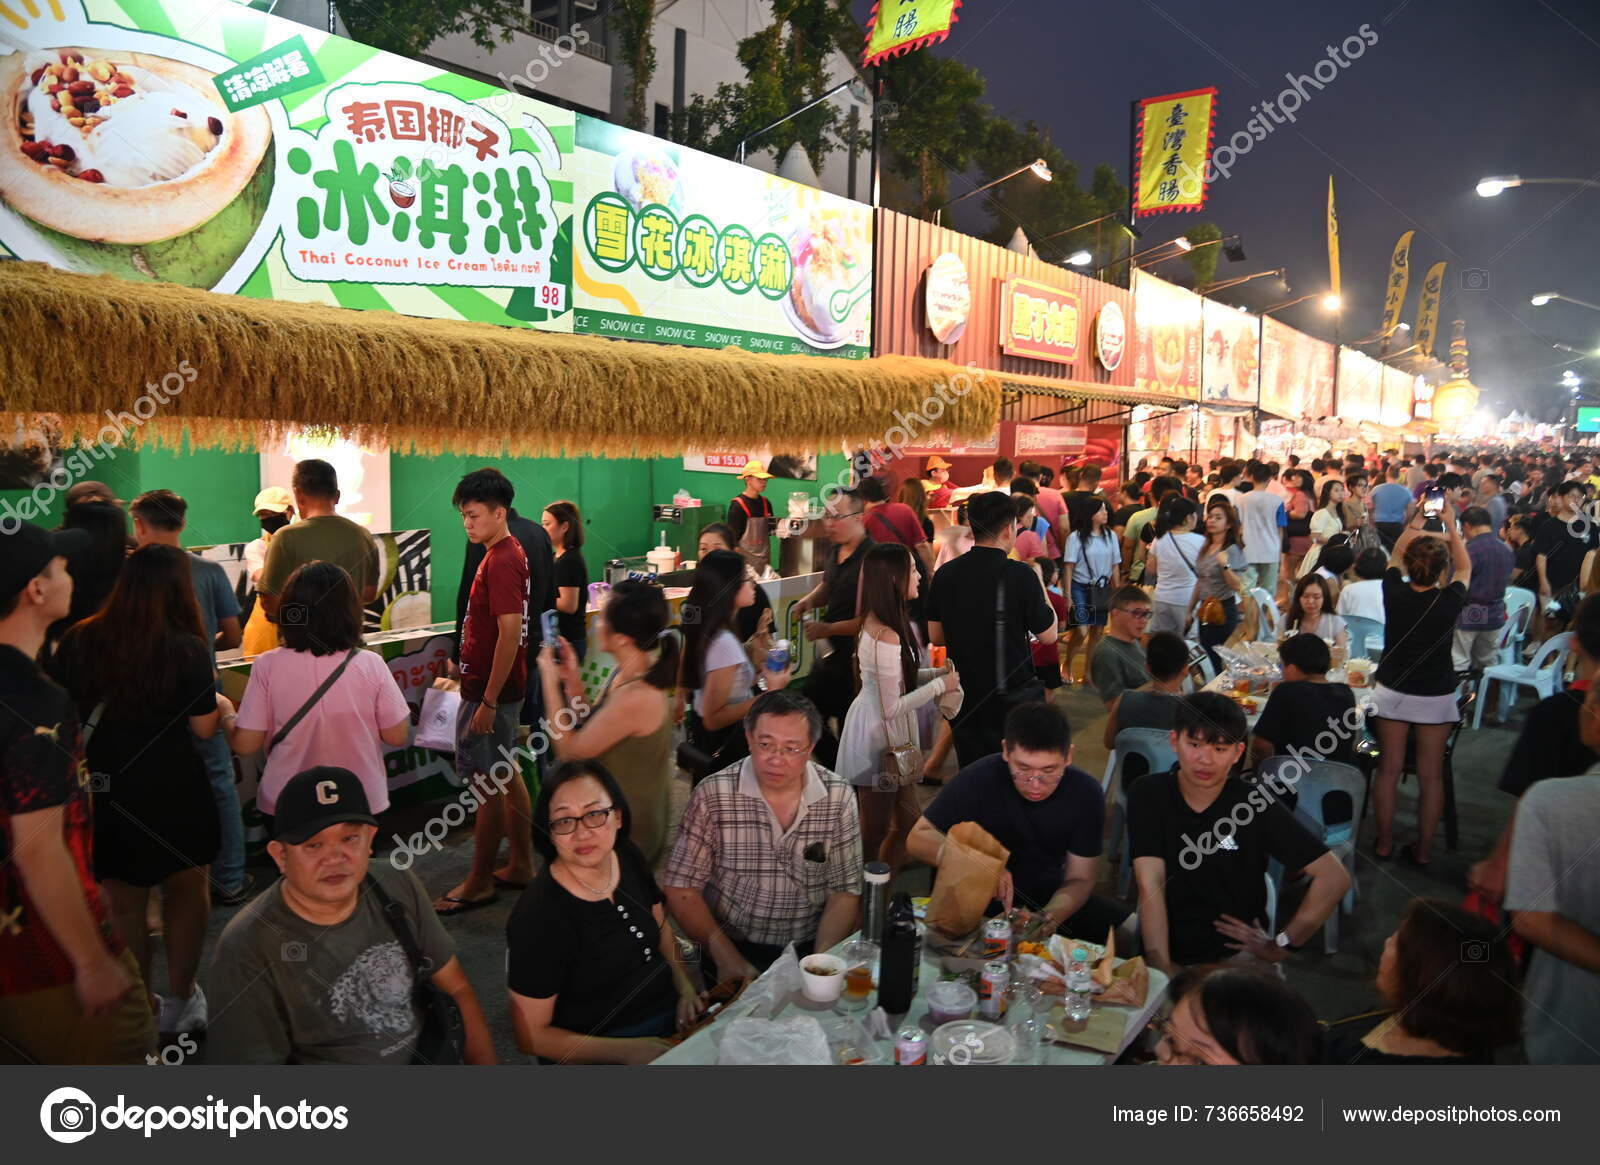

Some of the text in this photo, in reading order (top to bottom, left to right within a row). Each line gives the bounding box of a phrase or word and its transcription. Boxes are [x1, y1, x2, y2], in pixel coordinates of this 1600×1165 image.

[342, 99, 500, 162] 泰国椰子
[1159, 103, 1189, 202] 臺灣香腸
[287, 139, 547, 256] 冰淇淋
[299, 250, 488, 272] Thai Coconut Ice Cream
[541, 285, 560, 307] 98
[600, 318, 630, 332] SNOW
[630, 322, 646, 334] ICE
[655, 325, 682, 339] SNOW
[682, 329, 697, 340] ICE
[705, 331, 731, 345] SNOW
[730, 334, 743, 346] ICE
[750, 337, 772, 350] SNOW
[772, 340, 784, 351] ICE
[706, 455, 747, 467] RM 15.00
[316, 780, 339, 805] C
